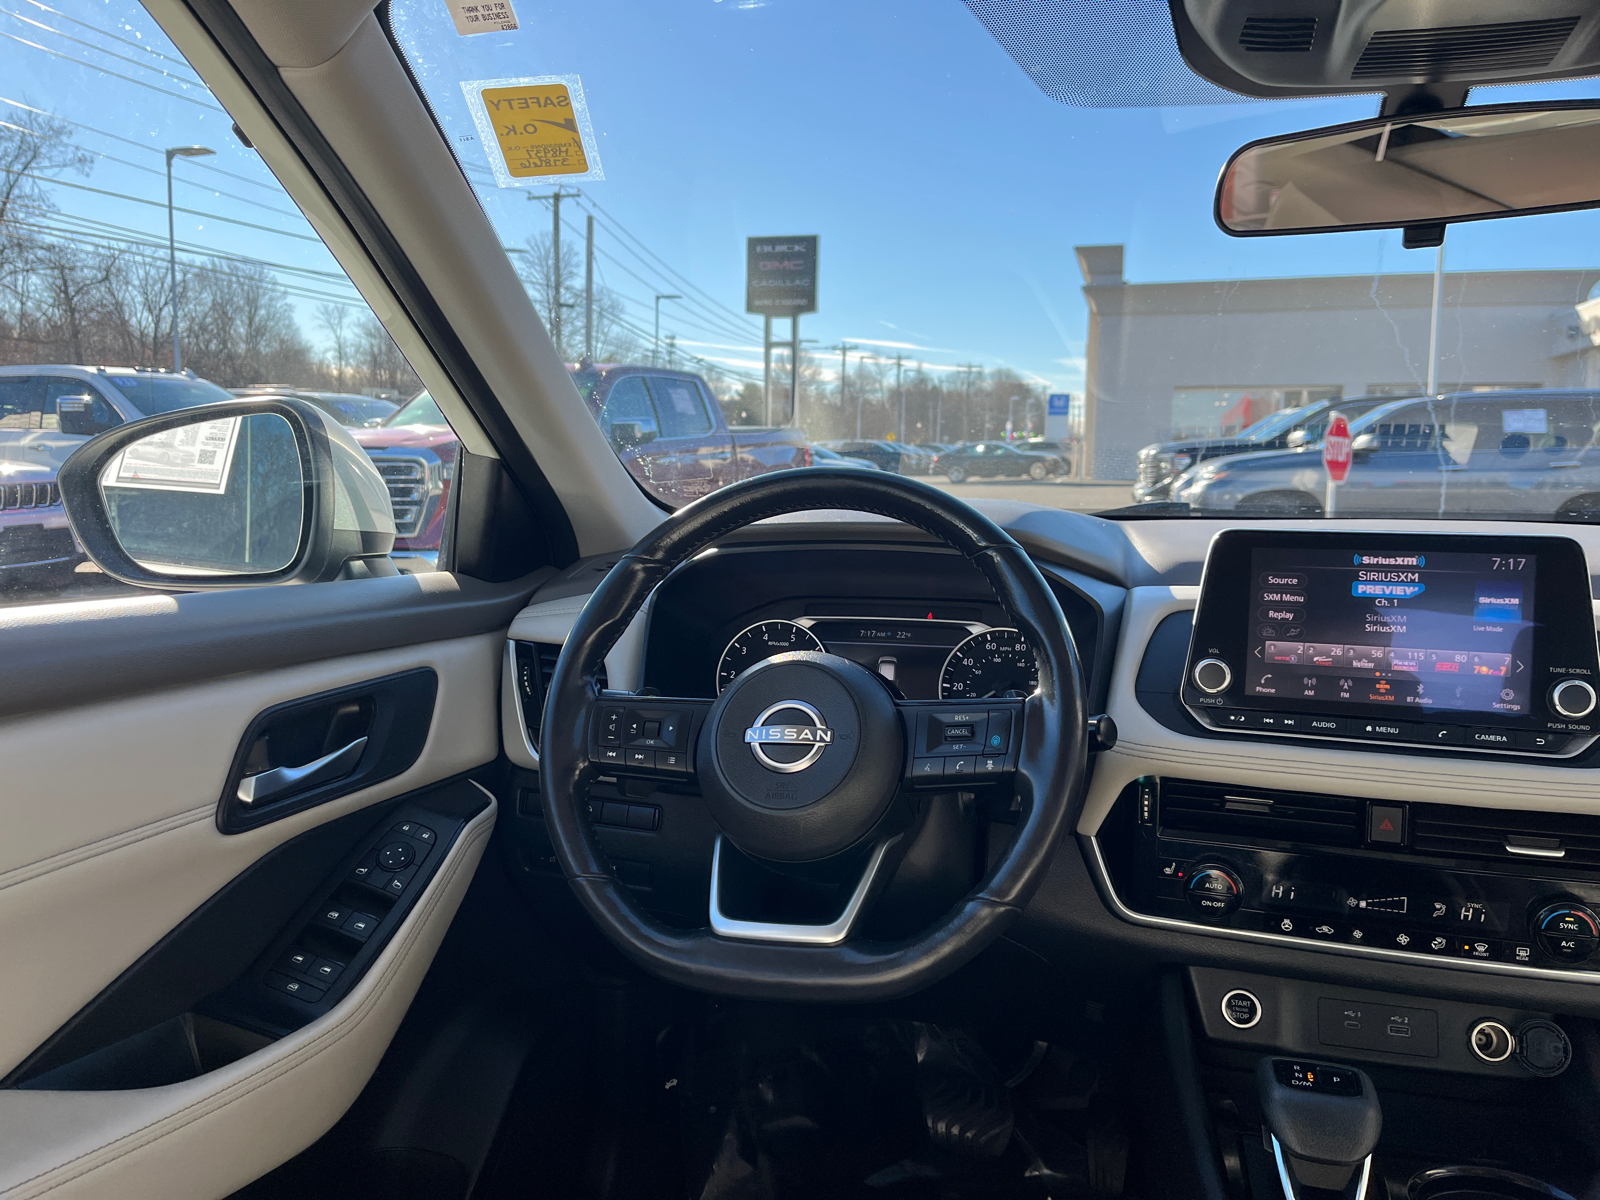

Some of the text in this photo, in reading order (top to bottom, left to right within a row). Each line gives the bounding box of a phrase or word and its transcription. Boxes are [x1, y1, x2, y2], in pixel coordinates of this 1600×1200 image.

[462, 2, 506, 14] THANK YOU FOR
[465, 12, 510, 23] YOUR BUSINESS
[756, 244, 806, 253] BUICK
[760, 260, 806, 270] GMC
[1326, 436, 1350, 462] STOP
[1492, 558, 1526, 570] 7:17
[1268, 576, 1298, 585] Source
[1358, 571, 1419, 582] SIRIUSXM
[1358, 584, 1418, 596] PREVIEW
[1263, 593, 1304, 602] SXM Menu
[1375, 598, 1390, 606] Ch.
[1479, 597, 1519, 605] SiriusXM
[1268, 610, 1294, 620] Replay
[1365, 614, 1407, 623] SiriusXM
[1365, 624, 1407, 633] SiriusXM
[1297, 646, 1303, 654] 2
[1330, 648, 1342, 656] 26
[1408, 652, 1424, 660] 115
[1492, 702, 1521, 710] Settings
[746, 729, 831, 742] NISSAN
[1475, 734, 1508, 742] CAMERA
[775, 782, 790, 790] SRS
[765, 792, 798, 800] AIRBAG
